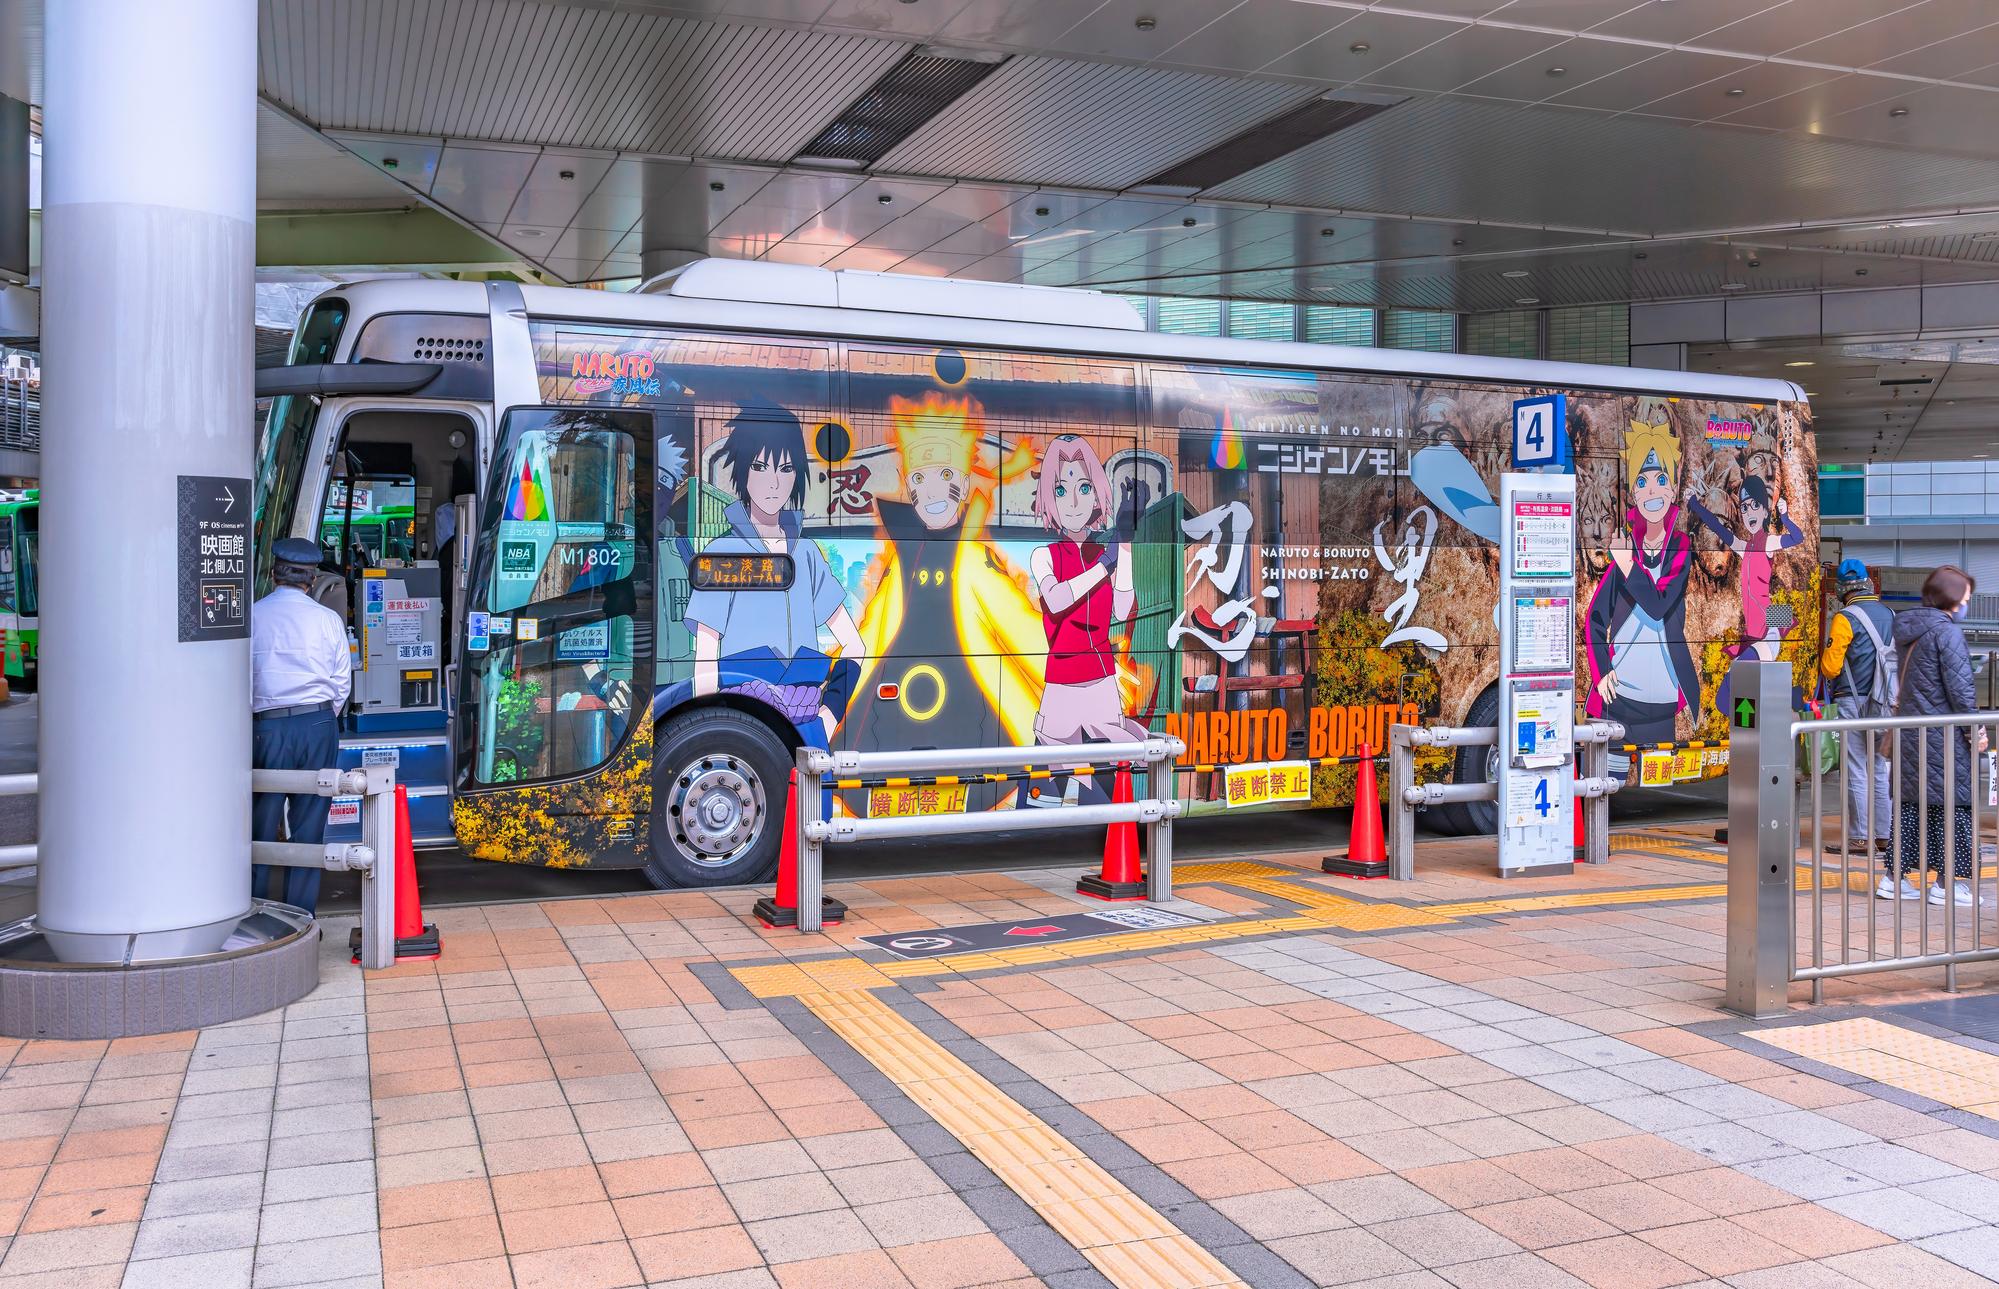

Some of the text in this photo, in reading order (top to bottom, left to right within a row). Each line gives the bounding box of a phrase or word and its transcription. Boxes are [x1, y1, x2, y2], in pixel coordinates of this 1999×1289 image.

[571, 351, 655, 379] NARUTO
[1258, 422, 1412, 438] NIJIGEN NO MORI
[1526, 411, 1544, 452] 4
[1706, 420, 1752, 441] BORUTO
[1257, 444, 1412, 476] ニジゲンノモリ
[199, 521, 209, 529] 9F
[211, 521, 221, 529] OS
[201, 534, 244, 556] 映画館
[507, 548, 531, 558] NBA
[1260, 547, 1370, 558] NARUTO & BORUTO
[200, 558, 244, 575] 北側入口
[560, 548, 621, 566] M1802
[400, 644, 433, 658] 運賃箱
[1166, 707, 1288, 766] NARUTO
[1643, 753, 1700, 781] 横断禁止
[1229, 771, 1308, 800] 横断禁止
[871, 789, 965, 817] 横断禁止
[1535, 779, 1551, 818] 4
